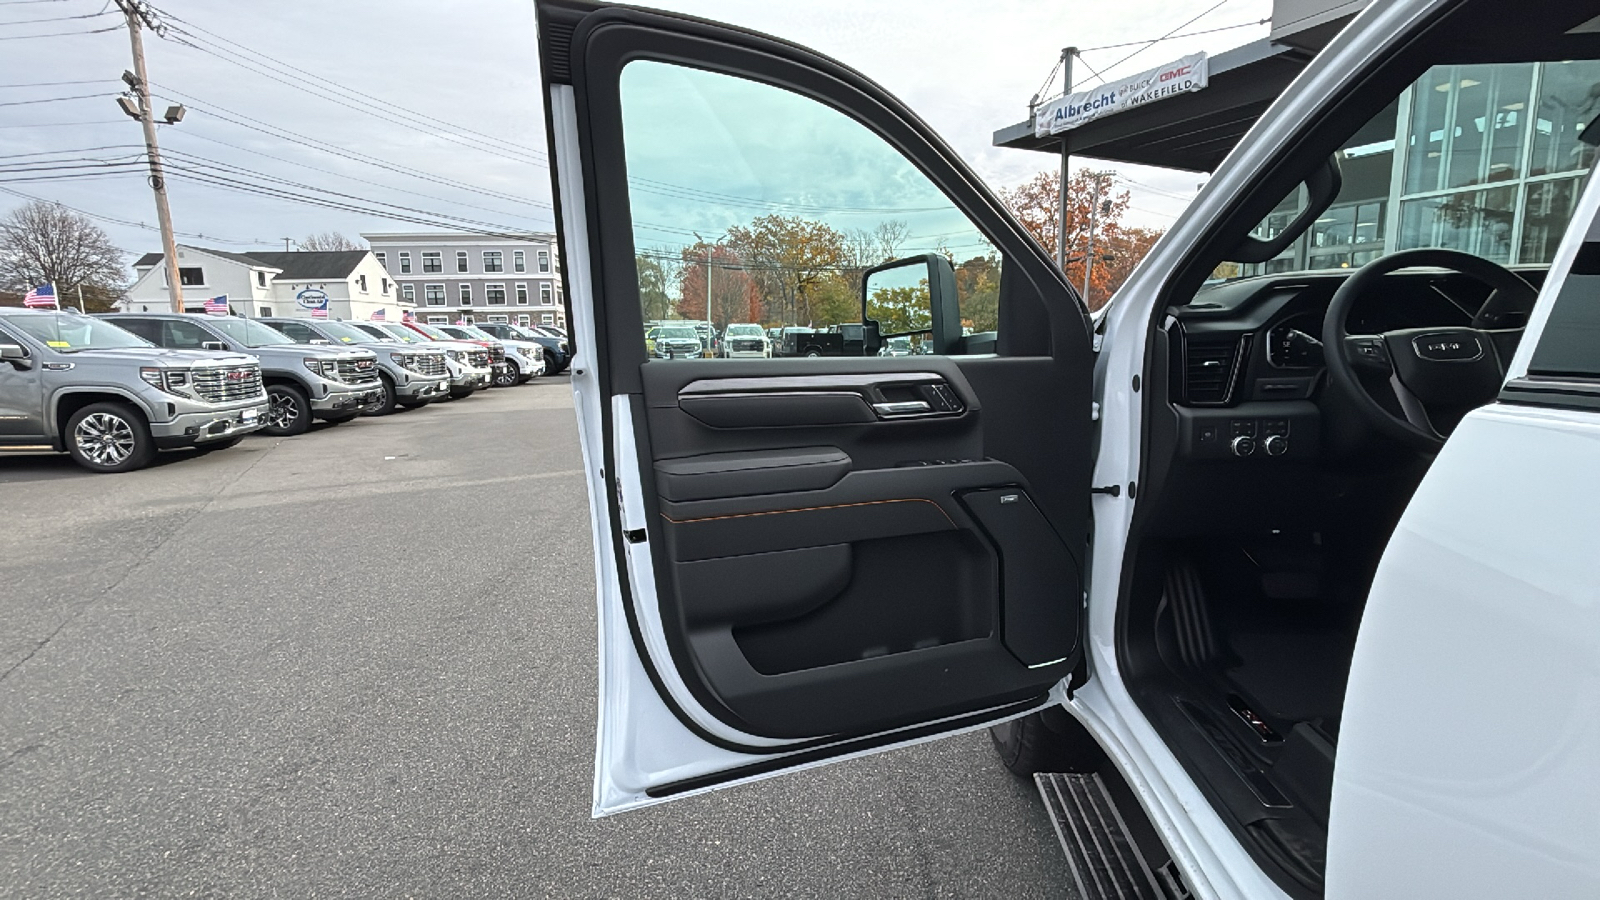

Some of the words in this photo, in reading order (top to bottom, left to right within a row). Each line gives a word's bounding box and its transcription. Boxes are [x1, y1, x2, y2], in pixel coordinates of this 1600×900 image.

[1160, 65, 1192, 82] GMC
[1129, 78, 1152, 93] BUICK
[1131, 80, 1192, 105] WAKEFIELD
[1055, 91, 1116, 121] Albrecht
